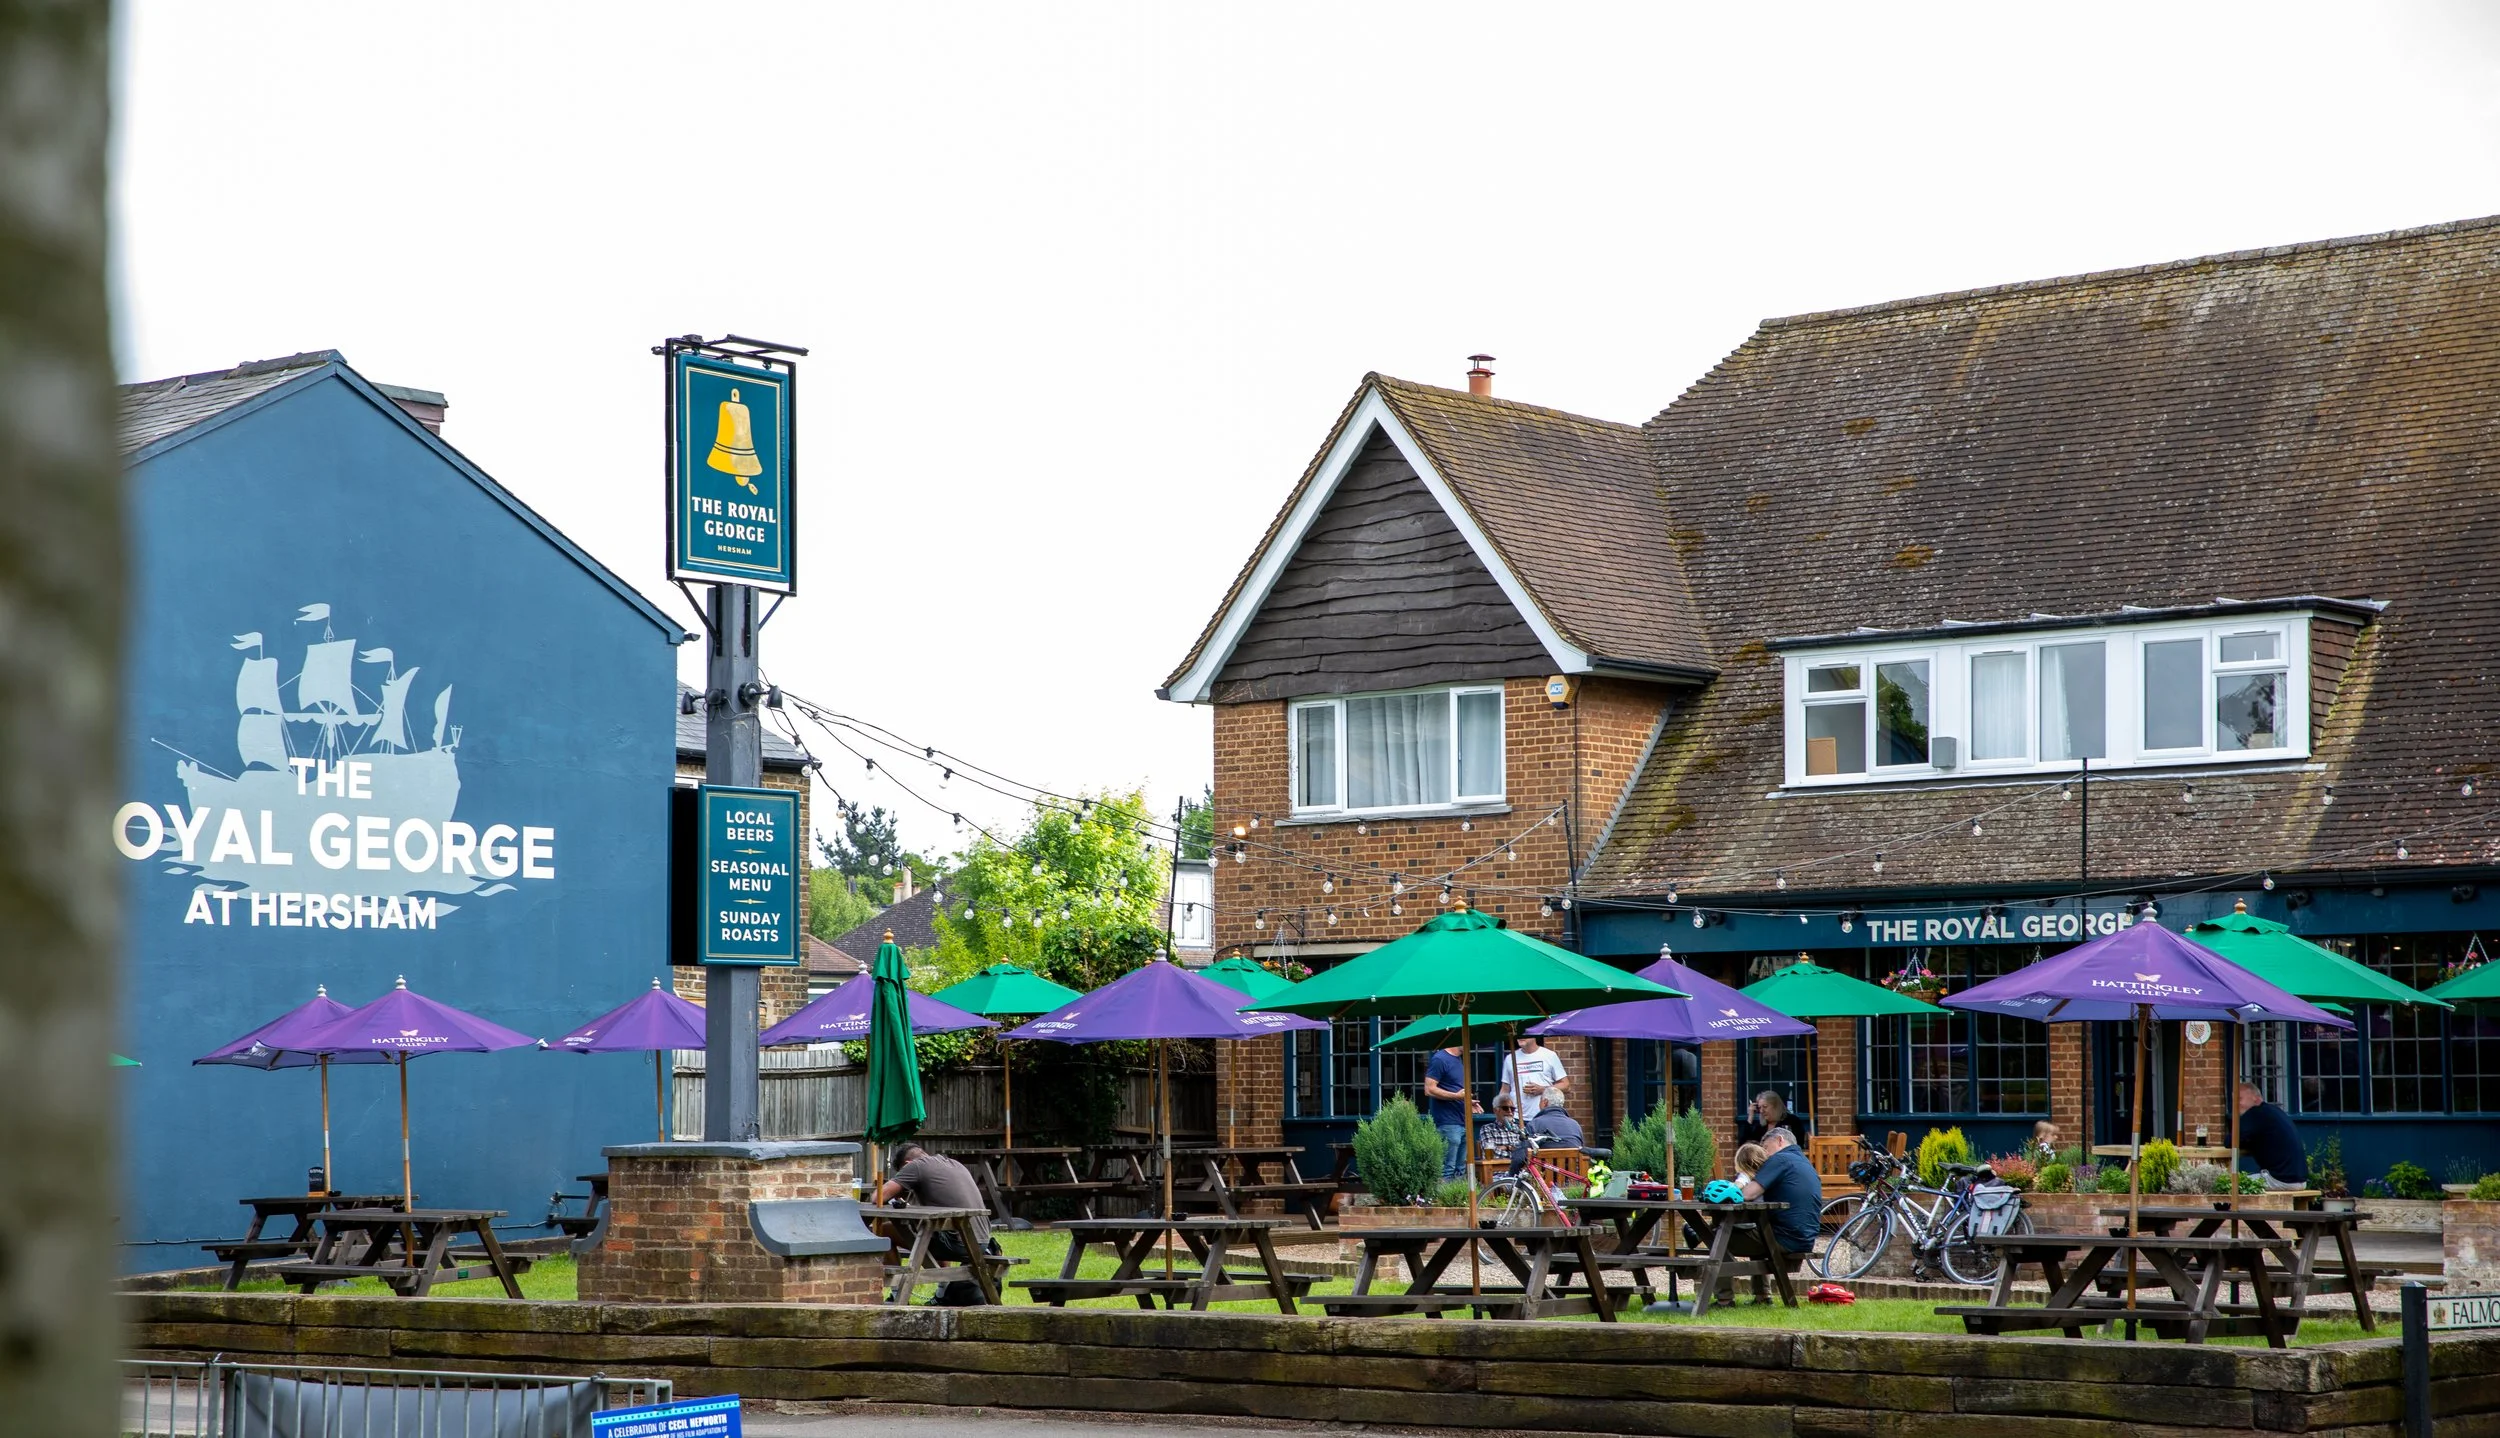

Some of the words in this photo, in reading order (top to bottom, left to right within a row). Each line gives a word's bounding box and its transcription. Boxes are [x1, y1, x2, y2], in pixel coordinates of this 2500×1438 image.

[692, 496, 722, 515] THE
[728, 502, 776, 523] ROYAL
[704, 520, 765, 543] GEORGE
[717, 545, 752, 555] HERSHAM
[289, 757, 372, 799] THE
[726, 810, 774, 825] LOCAL
[112, 802, 293, 865] OYAL
[309, 812, 555, 880] GEORGE
[727, 827, 774, 842] BEERS
[711, 860, 789, 876] SEASONAL
[729, 878, 772, 891] MENU
[183, 890, 238, 925] AT
[251, 892, 437, 930] HERSHAM
[720, 911, 780, 925] SUNDAY
[722, 928, 779, 942] ROASTS
[1866, 920, 1918, 942] THE
[1925, 916, 2015, 941] ROYAL
[2022, 912, 2133, 938] GEORGE
[2092, 979, 2203, 995] HATTINGLEY
[2125, 988, 2170, 997] VALLEY
[820, 1020, 871, 1029] HATTING
[1708, 1018, 1772, 1028] HATTINGLEY
[2452, 1300, 2500, 1324] FALMO
[608, 1429, 613, 1438] A
[614, 1423, 657, 1438] CELEBRATION
[658, 1422, 667, 1432] OF
[668, 1419, 689, 1431] CECIL
[690, 1414, 727, 1428] HEPWORTH
